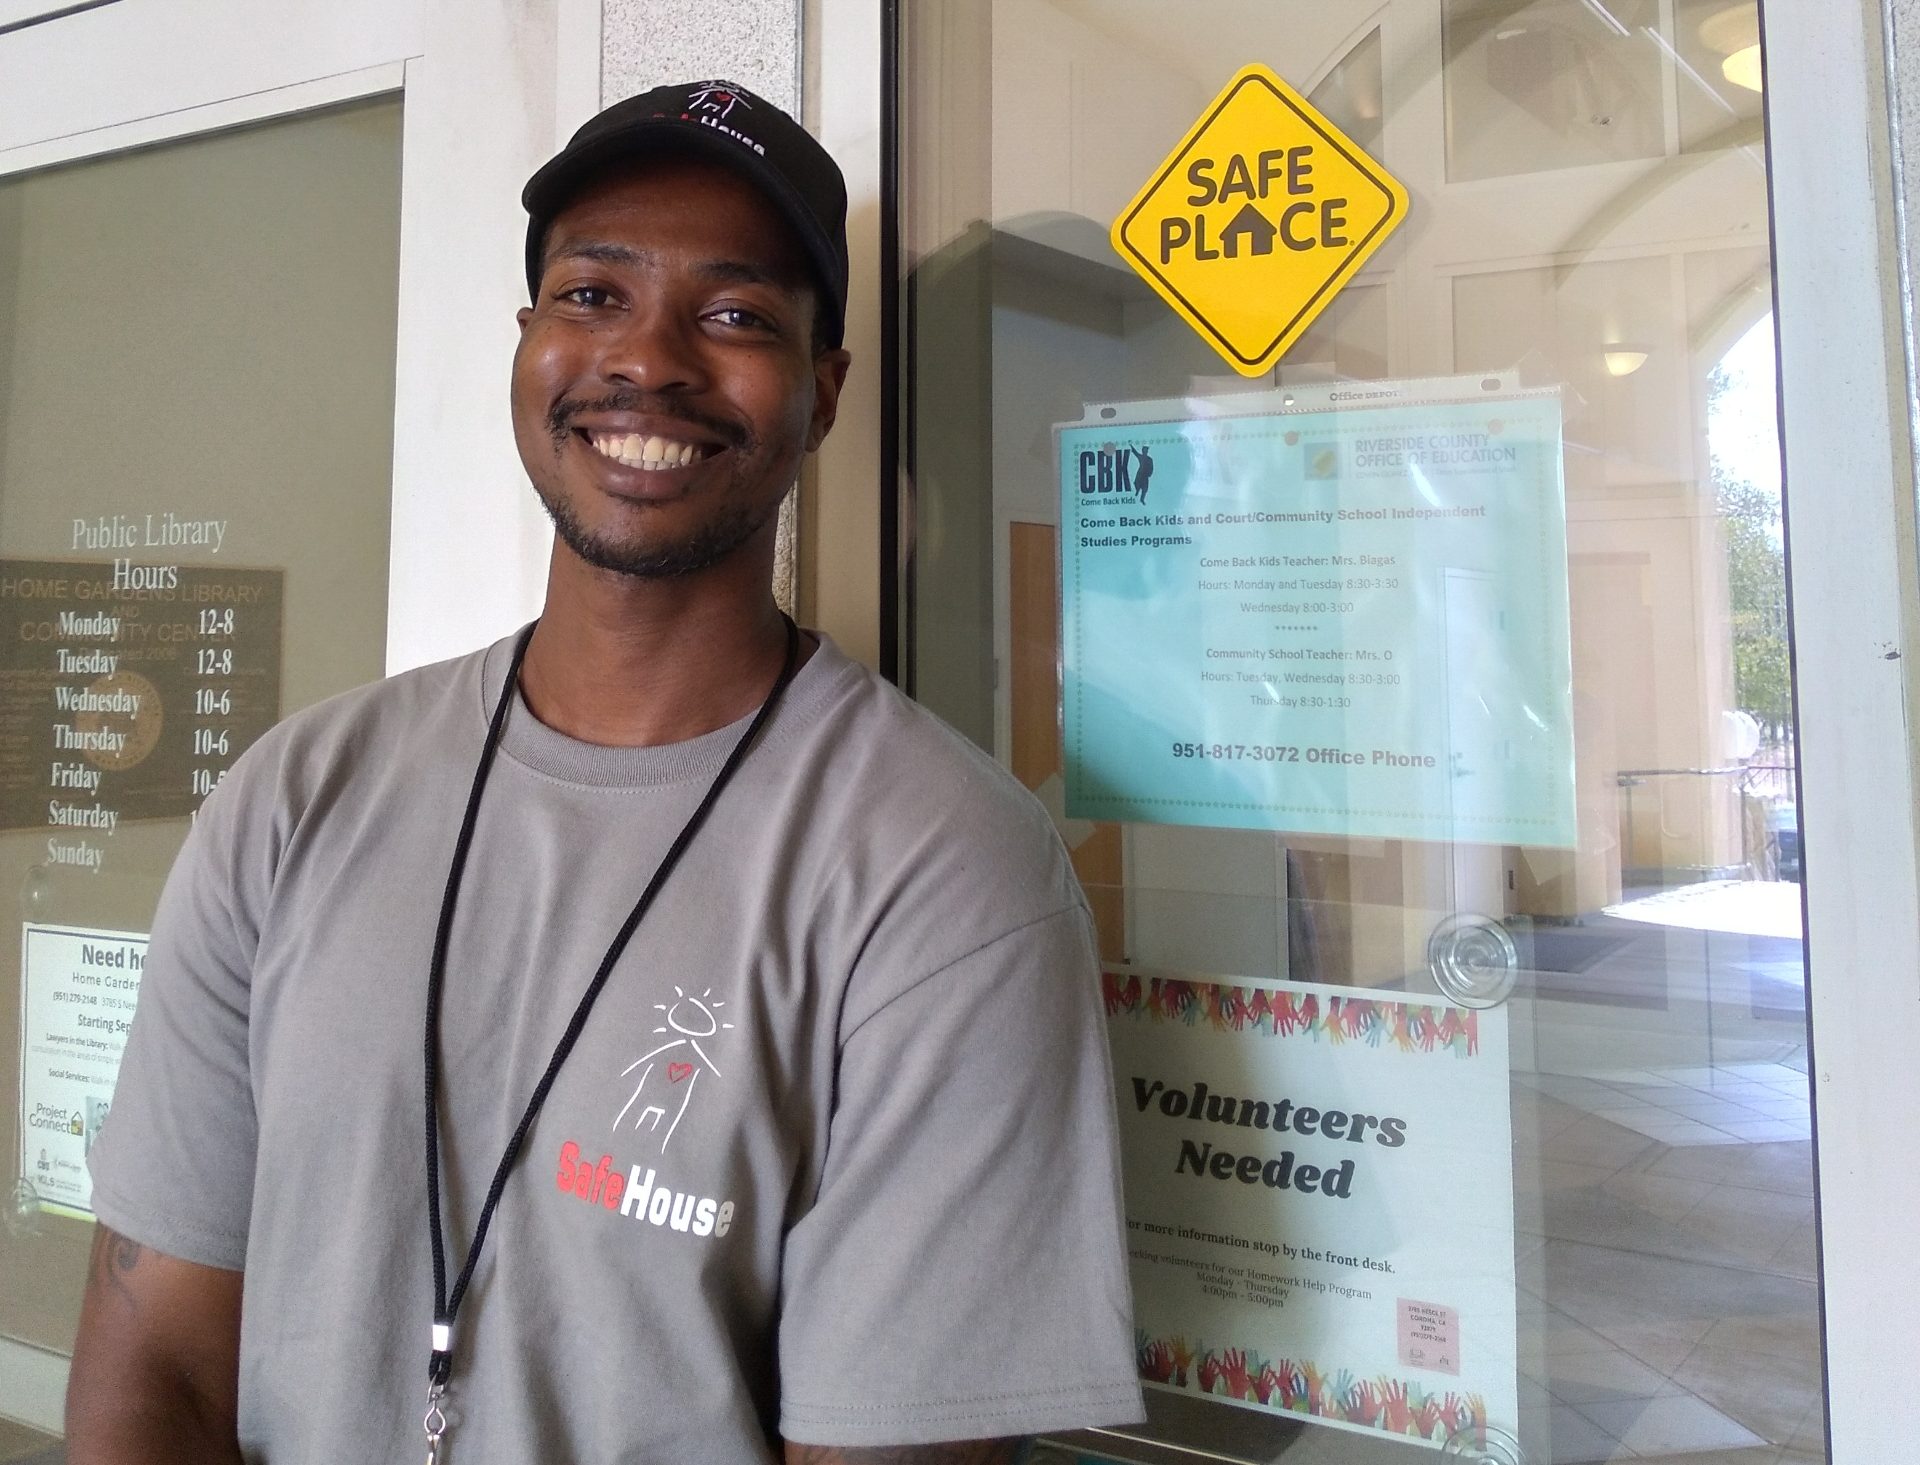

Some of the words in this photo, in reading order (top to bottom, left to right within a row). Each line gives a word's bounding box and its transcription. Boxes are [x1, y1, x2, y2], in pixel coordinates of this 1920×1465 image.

[1187, 145, 1314, 207] SAFE
[1160, 198, 1348, 265] PLACE
[1330, 392, 1364, 402] Office
[1355, 436, 1424, 452] RIVERSIDE
[1429, 433, 1489, 450] COUNTY
[1355, 453, 1403, 468] OFFICE
[1409, 451, 1426, 466] OF
[1433, 447, 1517, 464] EDUCATION
[1080, 448, 1132, 494] CBK
[1081, 498, 1102, 506] Come
[1103, 497, 1120, 505] Back
[1121, 496, 1136, 505] Kids
[1081, 517, 1116, 528] Come
[1119, 515, 1151, 527] Back
[1155, 514, 1184, 526] Kids
[1188, 513, 1212, 525] and
[1215, 509, 1333, 525] Court/Community
[1338, 508, 1387, 521] School
[1392, 505, 1486, 520] Independent
[71, 514, 138, 550] Public
[144, 512, 228, 554] Library
[1081, 535, 1128, 548] Studies
[1131, 534, 1193, 549] Programs
[1200, 557, 1230, 568] Come
[1232, 556, 1256, 568] Back
[1259, 556, 1281, 567] Kids
[1283, 556, 1329, 567] Teacher:
[1332, 555, 1356, 566] Mrs.
[1360, 554, 1396, 567] Biagas
[112, 558, 178, 590] Hours
[1198, 579, 1232, 590] Hours:
[1234, 579, 1275, 592] Monday
[1278, 579, 1297, 590] and
[1300, 578, 1343, 592] Tuesday
[1346, 578, 1399, 589] 8:30-3:30
[2, 578, 69, 599] HOME
[182, 584, 263, 603] LIBRARY
[1240, 602, 1301, 616] Wednesday
[1303, 602, 1354, 613] 8:00-3:00
[58, 609, 122, 642] Monday
[198, 608, 235, 635] 12-8
[56, 648, 119, 681] Tuesday
[196, 648, 233, 675] 12-8
[1206, 648, 1266, 661] Community
[1268, 648, 1304, 660] School
[1306, 649, 1353, 661] Teacher:
[1355, 649, 1381, 661] Mrs.
[1201, 671, 1234, 682] Hours:
[1237, 672, 1281, 684] Tuesday,
[1284, 673, 1345, 686] Wednesday
[1348, 673, 1401, 685] 8:30-3:00
[55, 686, 143, 720] Wednesday
[195, 688, 232, 716] 10-6
[1250, 695, 1298, 709] Thursday
[1299, 696, 1351, 708] 8:30-1:30
[53, 724, 127, 759] Thursday
[193, 728, 230, 756] 10-6
[1172, 742, 1300, 763] 951-817-3072
[1305, 747, 1366, 765] Office
[1372, 750, 1436, 768] Phone
[50, 762, 103, 796] Friday
[48, 799, 120, 836] Saturday
[47, 837, 104, 874] Sunday
[82, 943, 125, 969] Need
[72, 971, 102, 986] Home
[78, 1013, 114, 1034] Starting
[46, 1032, 69, 1044] Lawyers
[76, 1036, 86, 1047] the
[86, 1037, 109, 1052] Library:
[48, 1068, 65, 1079] Social
[65, 1070, 91, 1084] Services:
[36, 1102, 67, 1120] Project
[1131, 1076, 1408, 1148] Volunteers
[29, 1113, 71, 1135] Connect
[1174, 1138, 1356, 1200] Needed
[556, 1140, 736, 1239] SafeHouse
[1125, 1216, 1142, 1231] or
[1144, 1221, 1175, 1236] more
[1178, 1225, 1250, 1250] information
[1252, 1240, 1280, 1257] stop
[1283, 1243, 1298, 1261] by
[1301, 1247, 1322, 1262] the
[1325, 1251, 1360, 1268] front
[1362, 1256, 1396, 1274] desk.
[1128, 1248, 1159, 1264] eeking
[1160, 1254, 1210, 1271] volunteers
[1212, 1262, 1226, 1274] for
[1228, 1266, 1245, 1277] our
[1246, 1267, 1300, 1288] Homework
[1302, 1278, 1327, 1294] Help
[1329, 1282, 1373, 1300] Program
[1196, 1271, 1235, 1289] Monday
[1244, 1279, 1290, 1299] Thursday
[1202, 1284, 1238, 1301] 4:00pm
